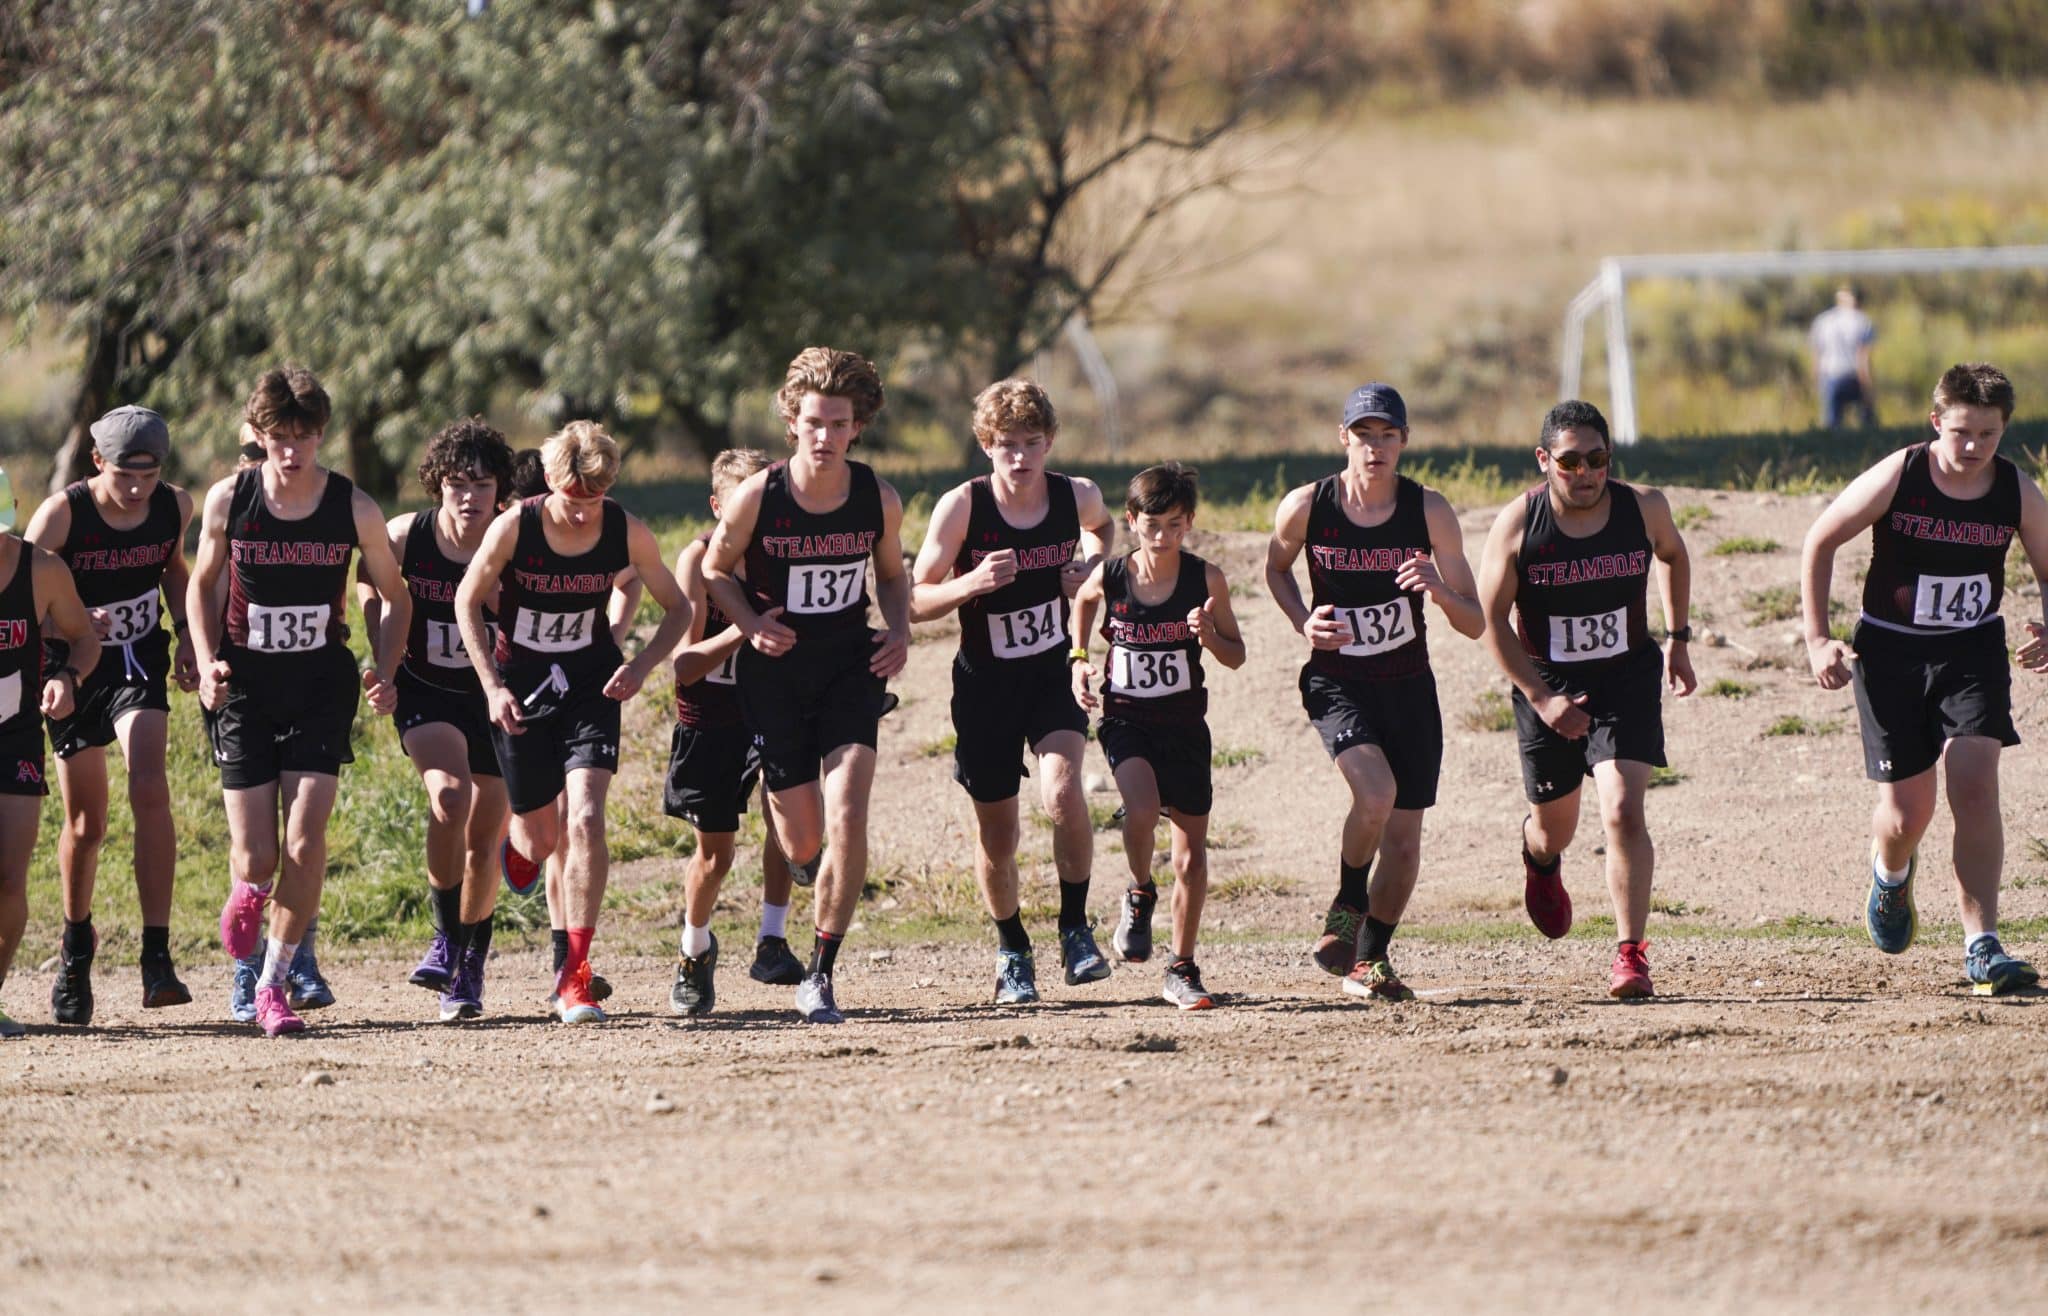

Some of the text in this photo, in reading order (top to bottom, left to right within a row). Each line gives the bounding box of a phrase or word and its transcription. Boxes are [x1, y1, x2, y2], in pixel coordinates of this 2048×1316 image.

[763, 531, 877, 558] STEAMBOAT
[1892, 512, 2016, 546] STEAMBOAT
[231, 539, 350, 566] STEAMBOAT
[971, 539, 1076, 570] SMBOAT
[1528, 550, 1646, 586] STEAMBOAT
[800, 567, 858, 609] 137
[1929, 581, 1983, 622] 143
[259, 611, 317, 650] 135
[527, 611, 586, 643] 144
[1000, 604, 1056, 649] 134
[1344, 602, 1405, 647] 132
[1561, 612, 1620, 654] 138
[1123, 651, 1180, 690] 136
